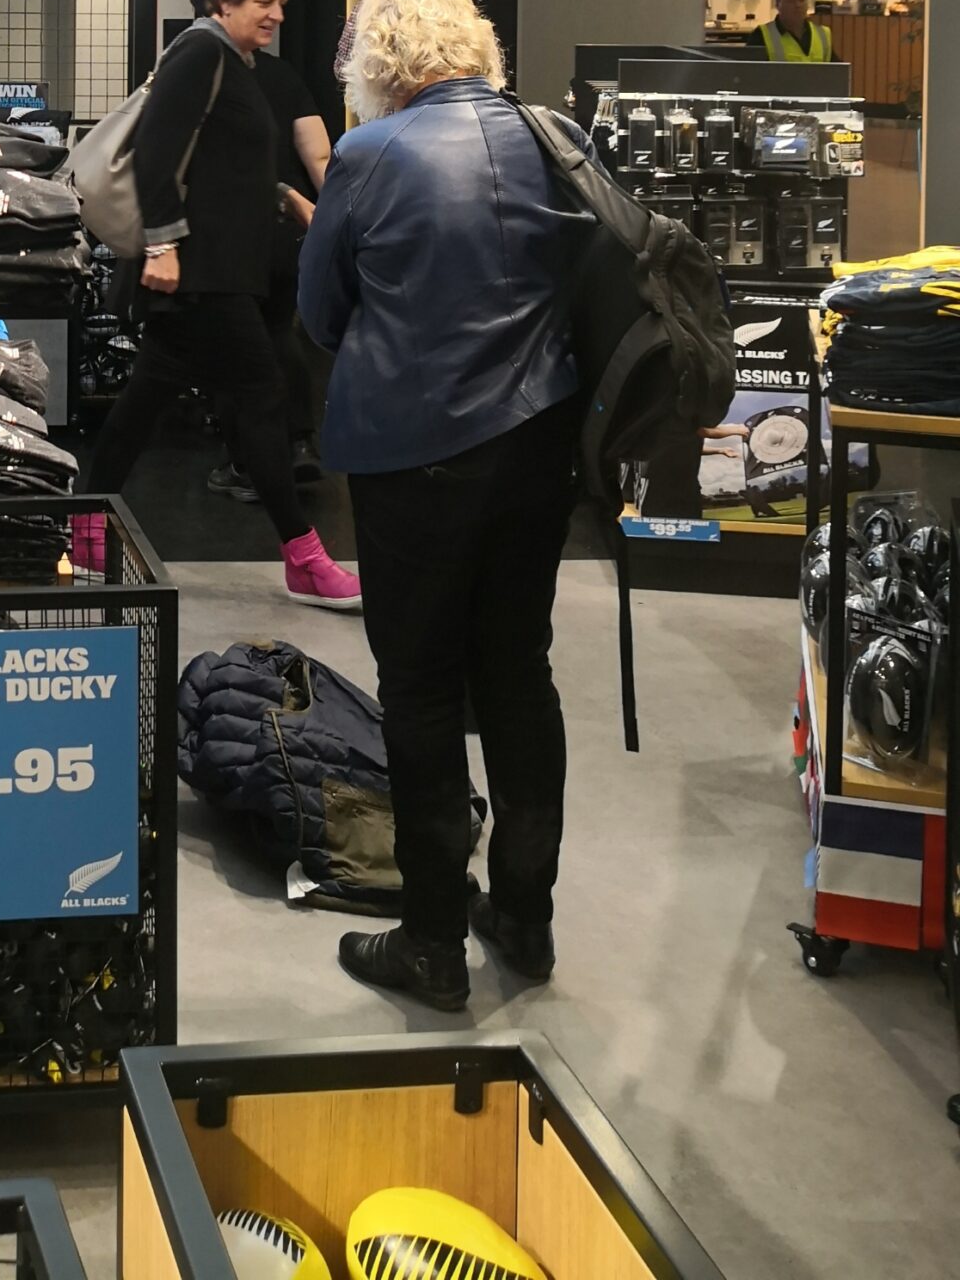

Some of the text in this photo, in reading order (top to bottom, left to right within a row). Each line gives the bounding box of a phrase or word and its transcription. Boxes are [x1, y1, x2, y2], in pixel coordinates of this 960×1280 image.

[745, 350, 785, 359] BLACKS
[6, 675, 117, 703] DUCKY
[61, 897, 127, 908] ALL BLACKS
